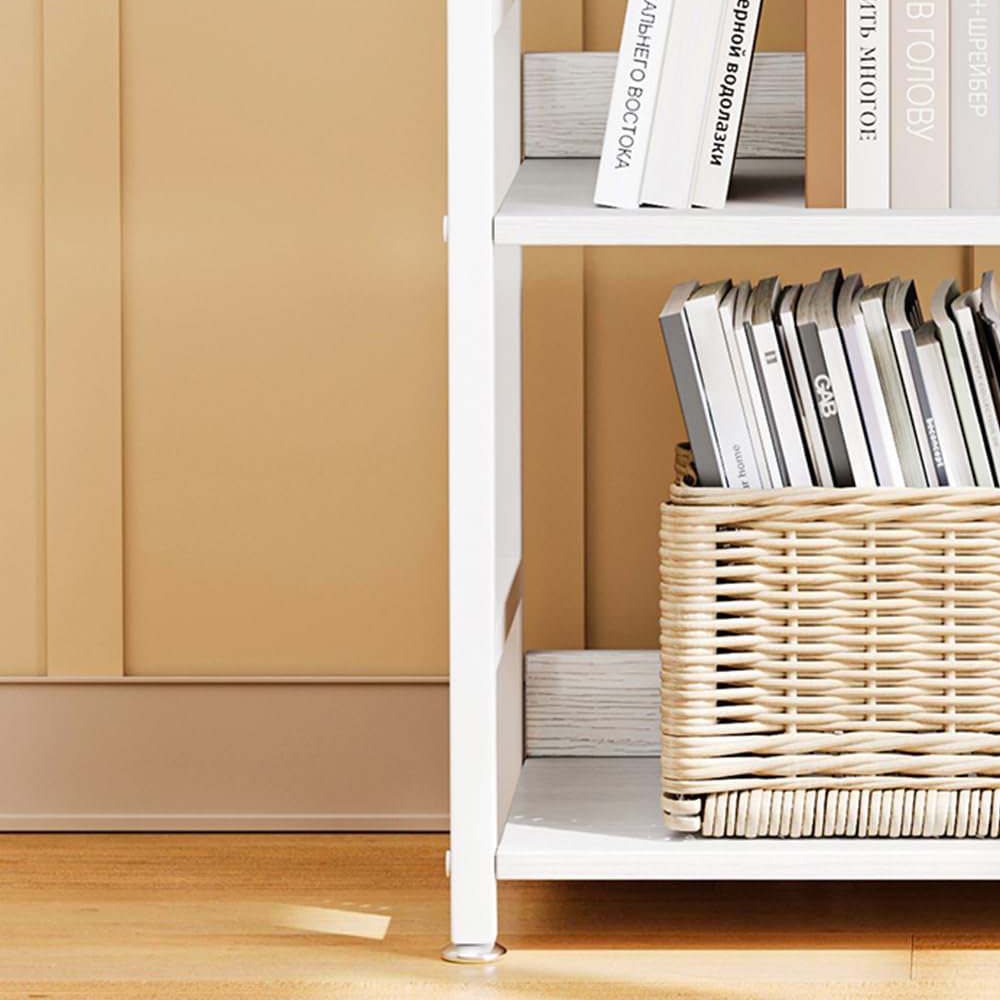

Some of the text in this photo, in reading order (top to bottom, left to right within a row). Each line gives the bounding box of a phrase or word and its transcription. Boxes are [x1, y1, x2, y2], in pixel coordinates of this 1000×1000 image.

[905, 1, 935, 20] В
[614, 86, 644, 170] ВОСТОКА
[710, 62, 739, 166] водолазки
[859, 47, 877, 141] МНОГОЕ
[905, 28, 935, 142] ГОЛОВУ
[813, 373, 838, 419] GAB
